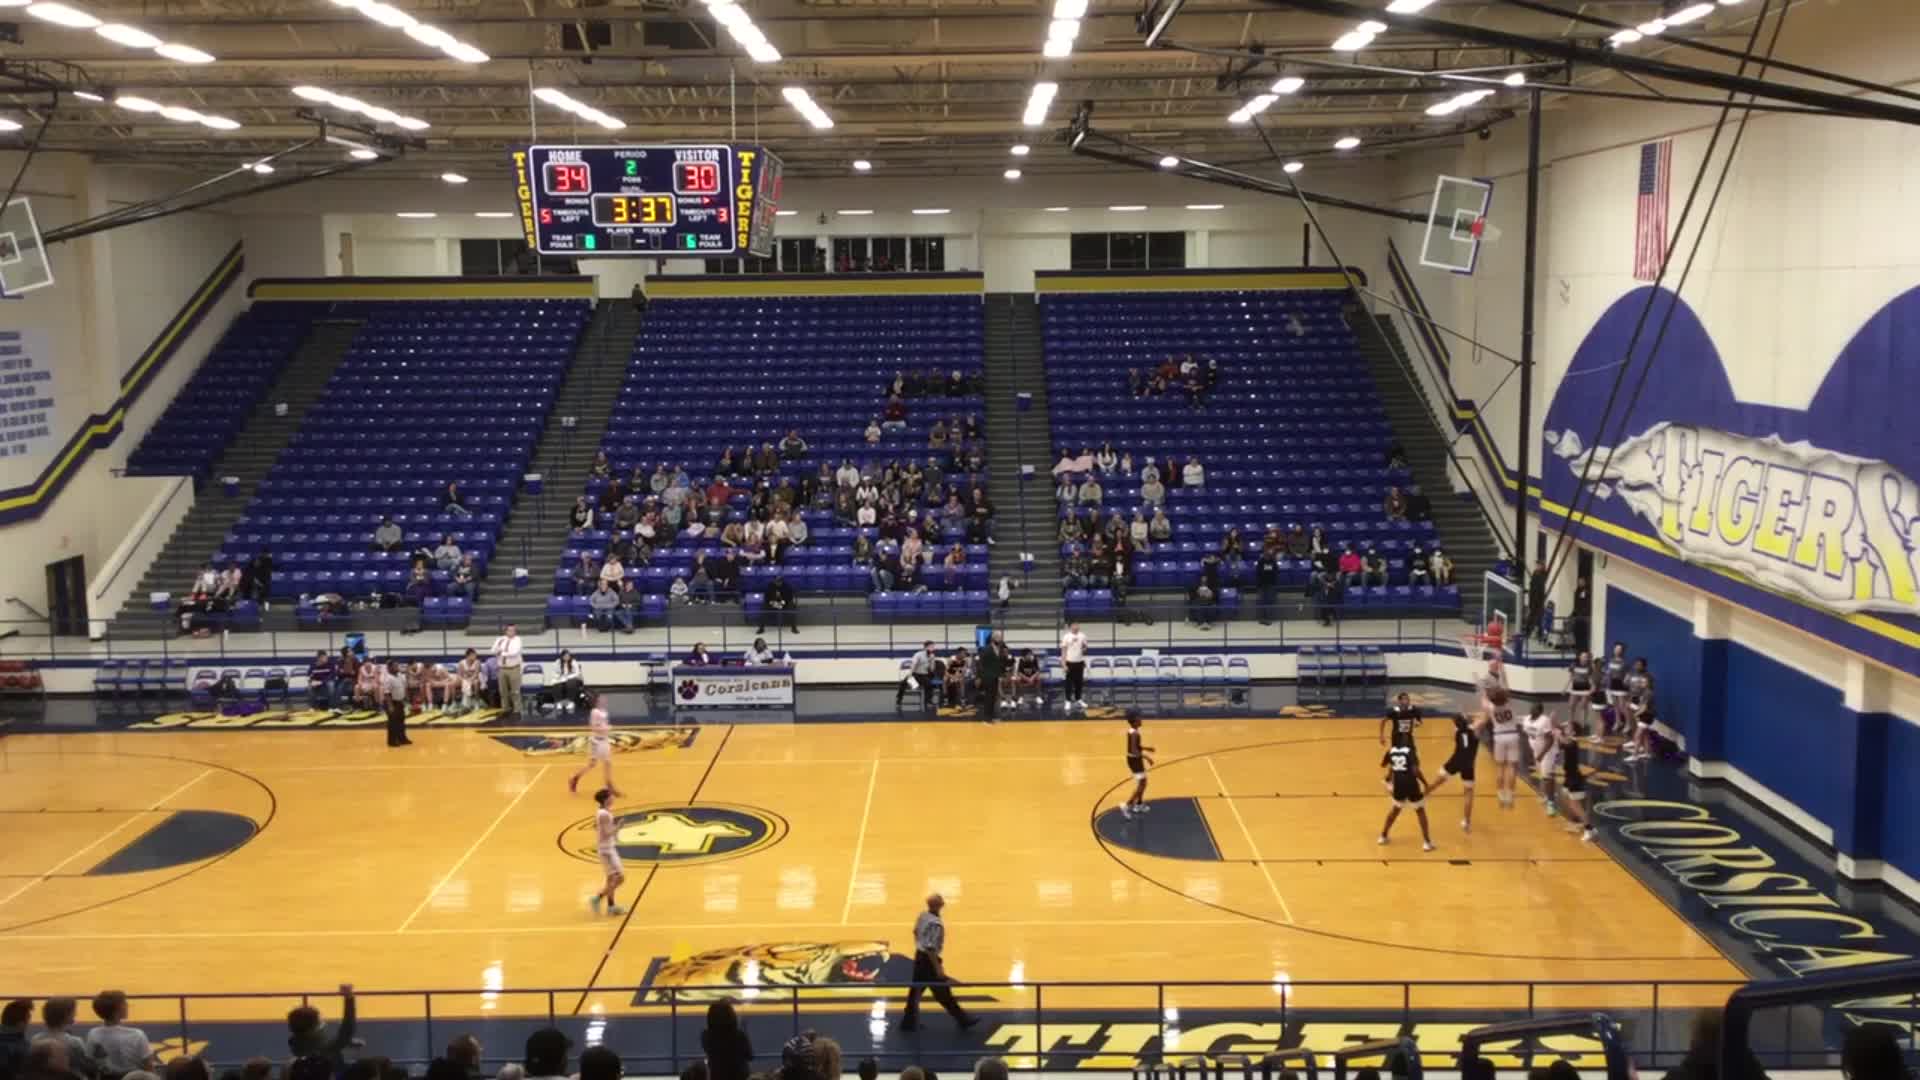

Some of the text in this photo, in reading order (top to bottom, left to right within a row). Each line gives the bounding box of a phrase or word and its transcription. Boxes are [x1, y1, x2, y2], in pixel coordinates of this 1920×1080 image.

[548, 150, 582, 162] HOME
[614, 150, 647, 159] PERIOD
[675, 149, 719, 161] VISITOR
[625, 160, 636, 175] 2
[555, 166, 586, 190] 34
[685, 165, 714, 189] 30
[513, 151, 537, 249] TIGERS
[736, 151, 755, 248] TIGERS
[541, 208, 551, 224] 5
[613, 197, 672, 222] 3:37
[719, 208, 728, 222] 3
[1391, 755, 1407, 770] 32
